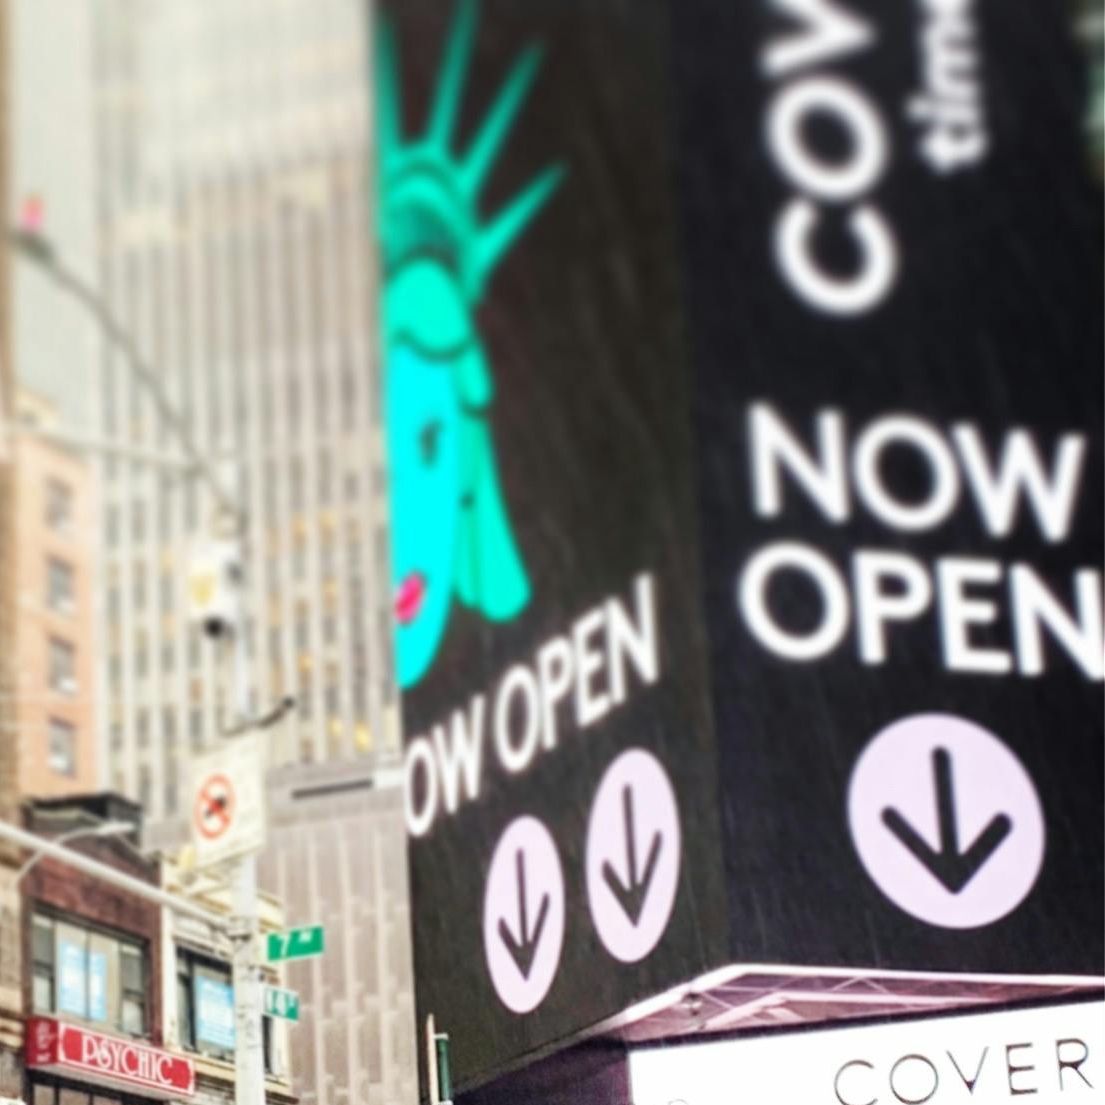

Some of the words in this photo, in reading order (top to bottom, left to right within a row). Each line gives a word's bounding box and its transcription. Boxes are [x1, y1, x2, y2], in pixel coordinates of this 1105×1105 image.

[762, 0, 898, 314] COV
[750, 402, 1085, 542] NOW
[740, 543, 1105, 682] OPEN
[403, 695, 485, 838] OW
[494, 573, 659, 772] OPEN
[81, 1034, 173, 1085] PSYCHIC
